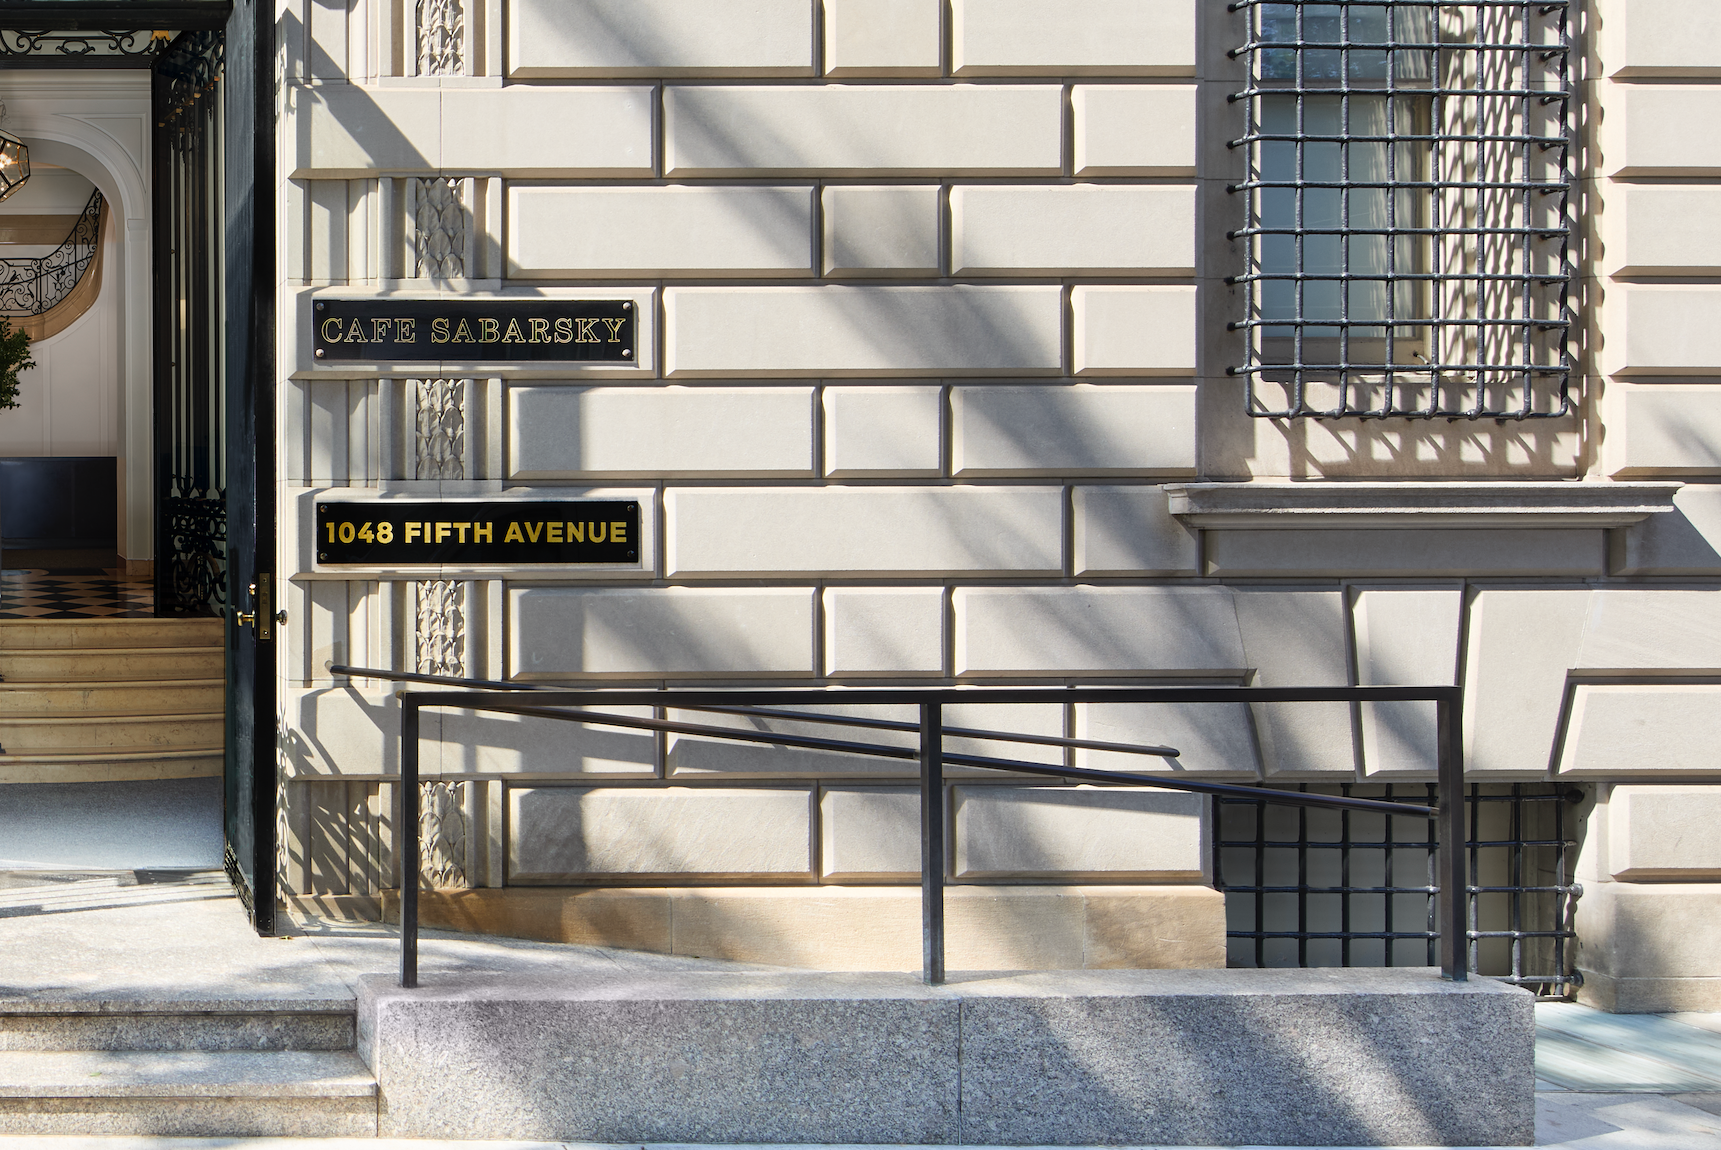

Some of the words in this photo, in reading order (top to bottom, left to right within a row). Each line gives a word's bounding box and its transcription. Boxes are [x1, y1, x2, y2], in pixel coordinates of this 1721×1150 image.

[321, 318, 416, 343] CAFE
[431, 318, 626, 343] SABARSKY
[326, 522, 394, 544] 1048
[405, 522, 493, 544] FIFTH
[504, 522, 627, 544] AVENUE
